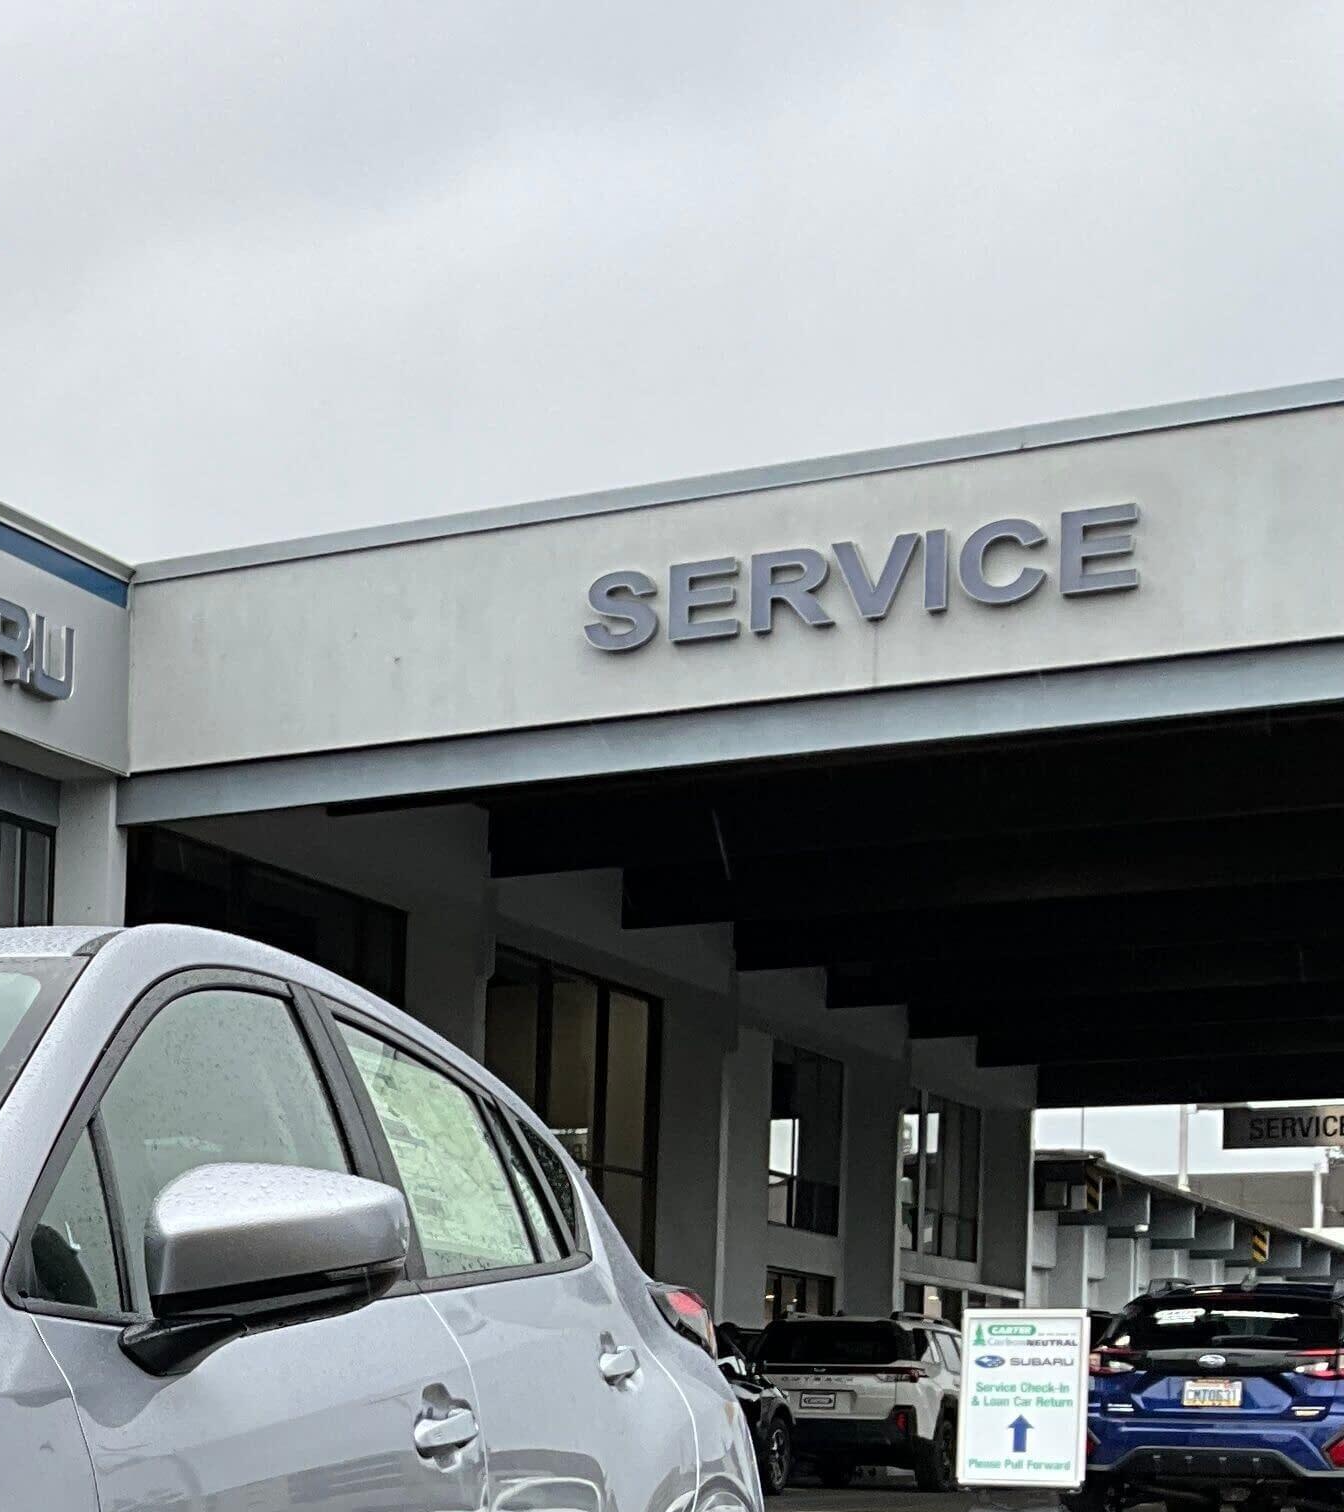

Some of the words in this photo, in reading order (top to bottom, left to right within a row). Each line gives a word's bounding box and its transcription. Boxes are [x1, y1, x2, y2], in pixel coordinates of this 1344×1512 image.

[583, 502, 1140, 653] SERVICE
[1010, 1357, 1074, 1367] SUBARU
[976, 1382, 1017, 1393] Service
[971, 1396, 980, 1406] &
[983, 1396, 1010, 1407] Loan
[1014, 1396, 1033, 1407] Car
[1036, 1396, 1074, 1408] Return
[1004, 1459, 1024, 1470] Pull
[1027, 1459, 1072, 1471] Forward
